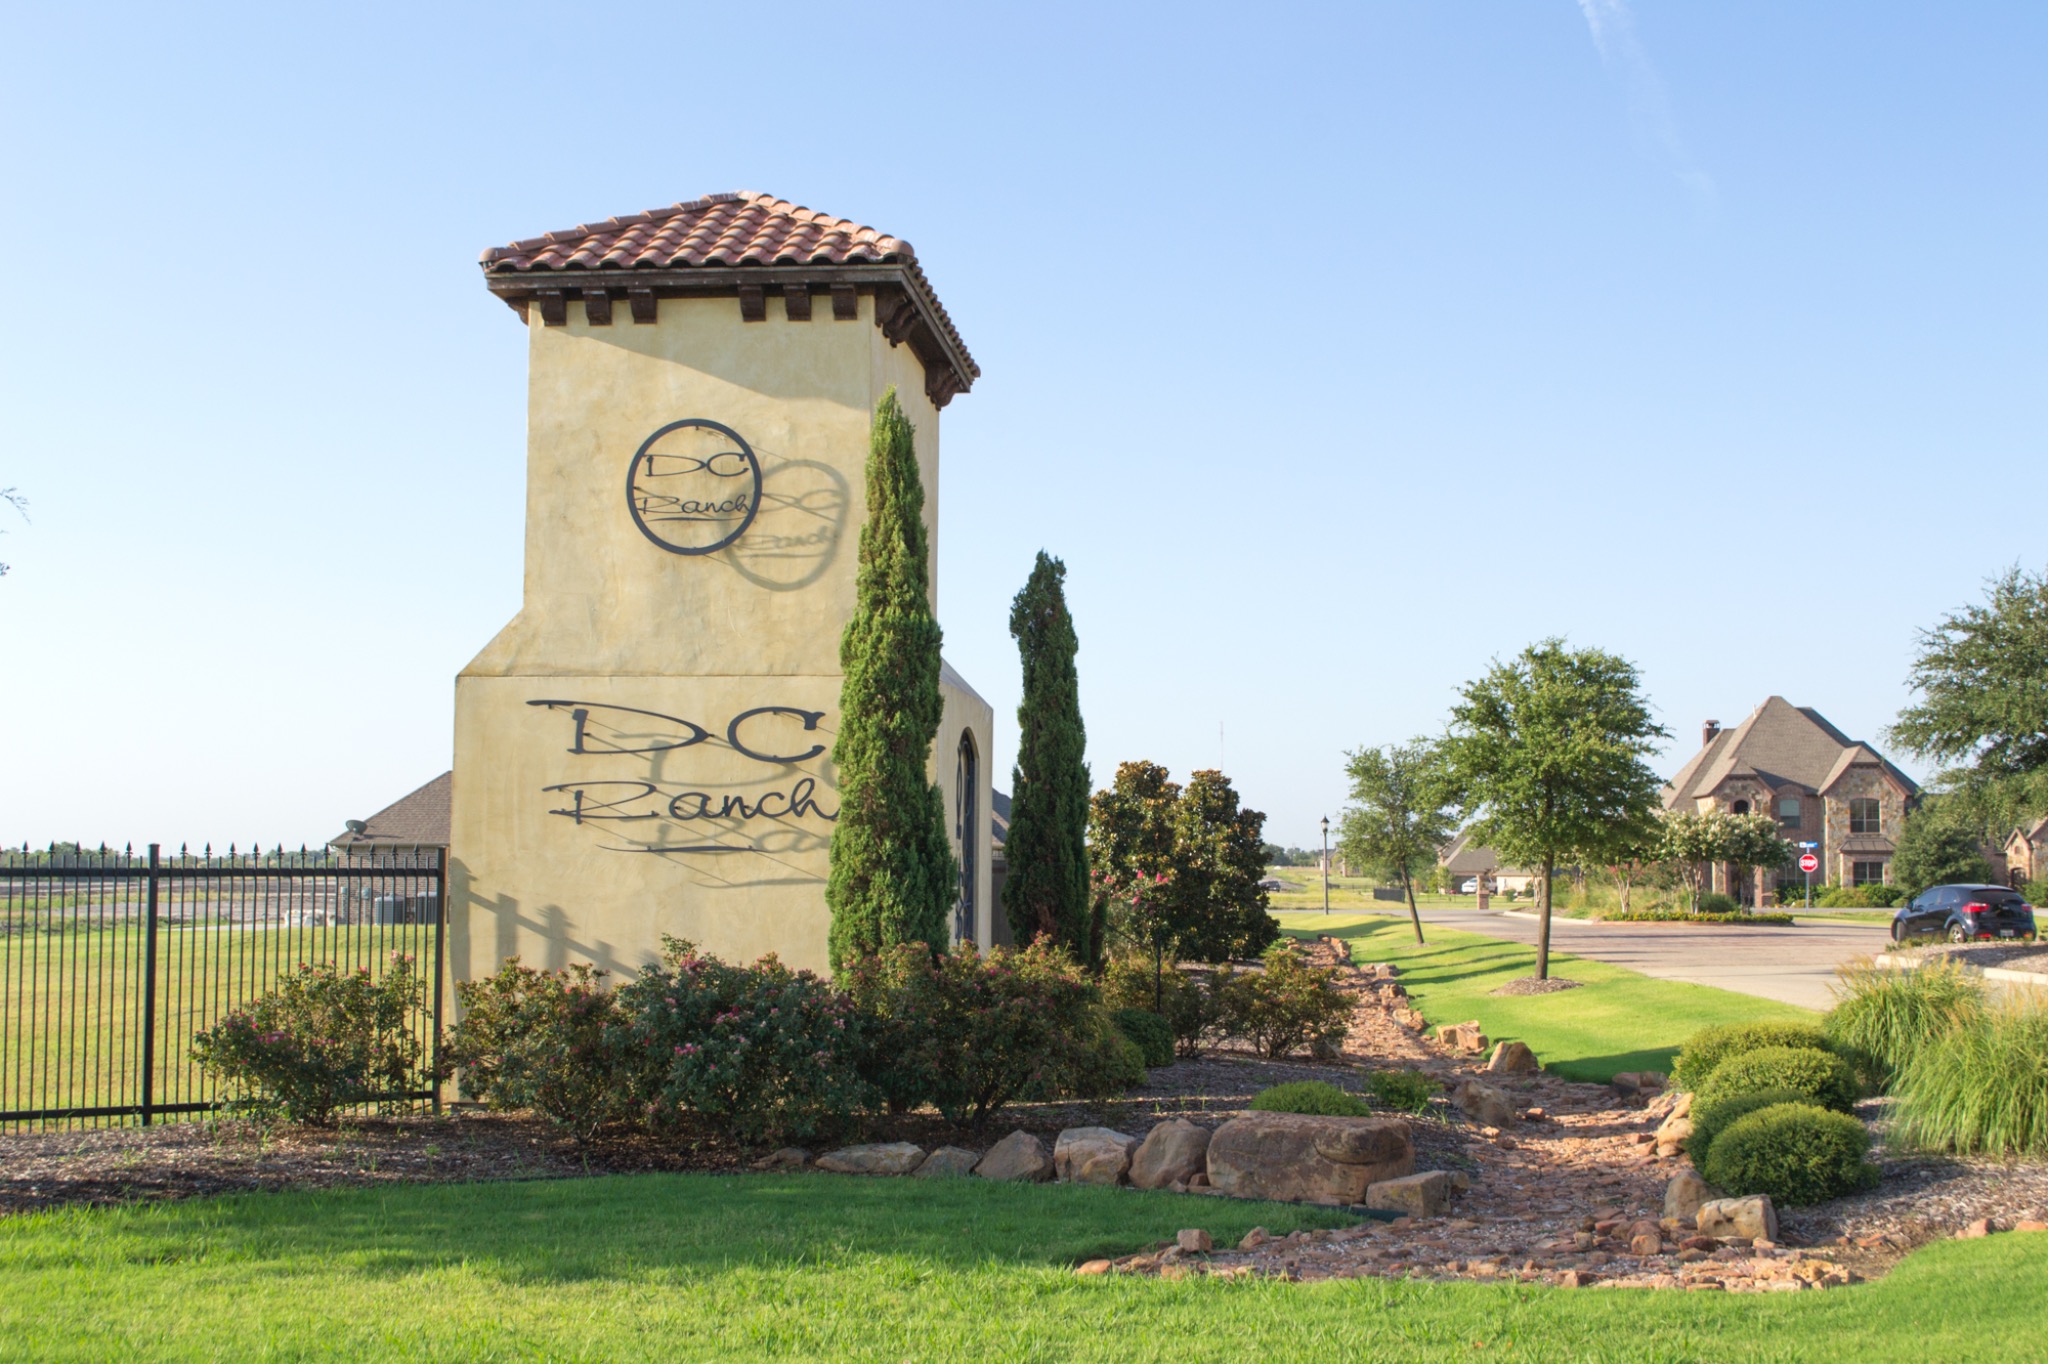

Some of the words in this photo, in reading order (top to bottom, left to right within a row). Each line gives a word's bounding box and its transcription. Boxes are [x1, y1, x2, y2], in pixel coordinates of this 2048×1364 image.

[640, 452, 750, 478] DC
[634, 494, 751, 515] Ranch
[526, 699, 827, 763] DC
[541, 777, 841, 825] Ranch
[1800, 859, 1817, 867] STOP
